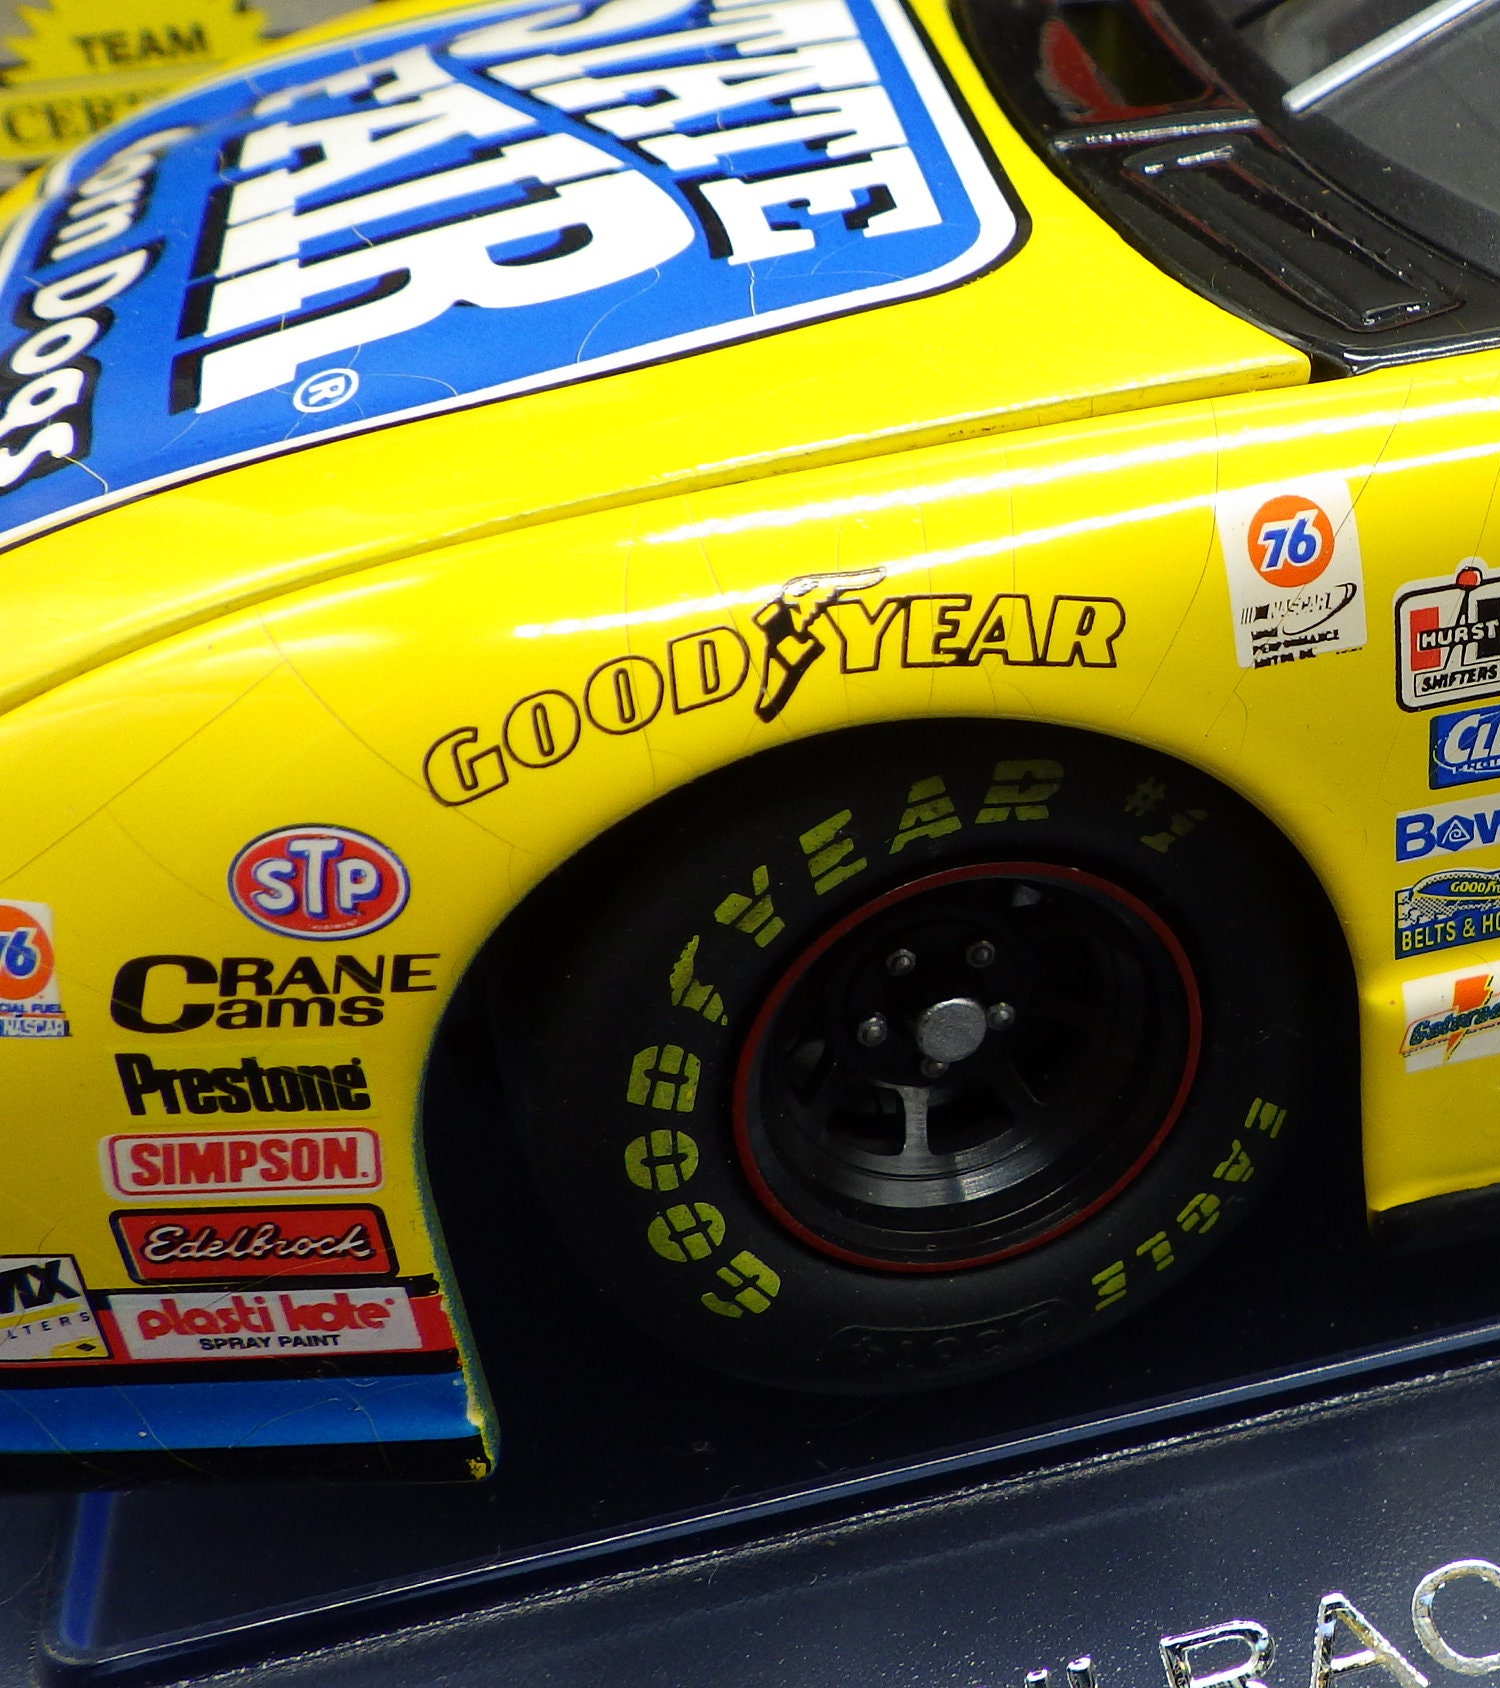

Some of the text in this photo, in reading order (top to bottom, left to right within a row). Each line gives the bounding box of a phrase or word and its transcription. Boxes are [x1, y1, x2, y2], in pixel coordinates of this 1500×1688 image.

[72, 22, 208, 66] TEAM
[194, 45, 696, 415] FAIR
[1258, 510, 1318, 571] 76
[1417, 618, 1500, 652] HURST
[1421, 663, 1498, 693] SHIFTERS
[249, 837, 382, 920] STP
[1402, 920, 1456, 951] BELTS
[1462, 917, 1475, 938] &
[114, 1053, 371, 1117] Prestone
[144, 1225, 373, 1262] Edelbrock
[137, 1292, 394, 1340] plasti kote
[200, 1334, 342, 1351] SPRAY PAINT
